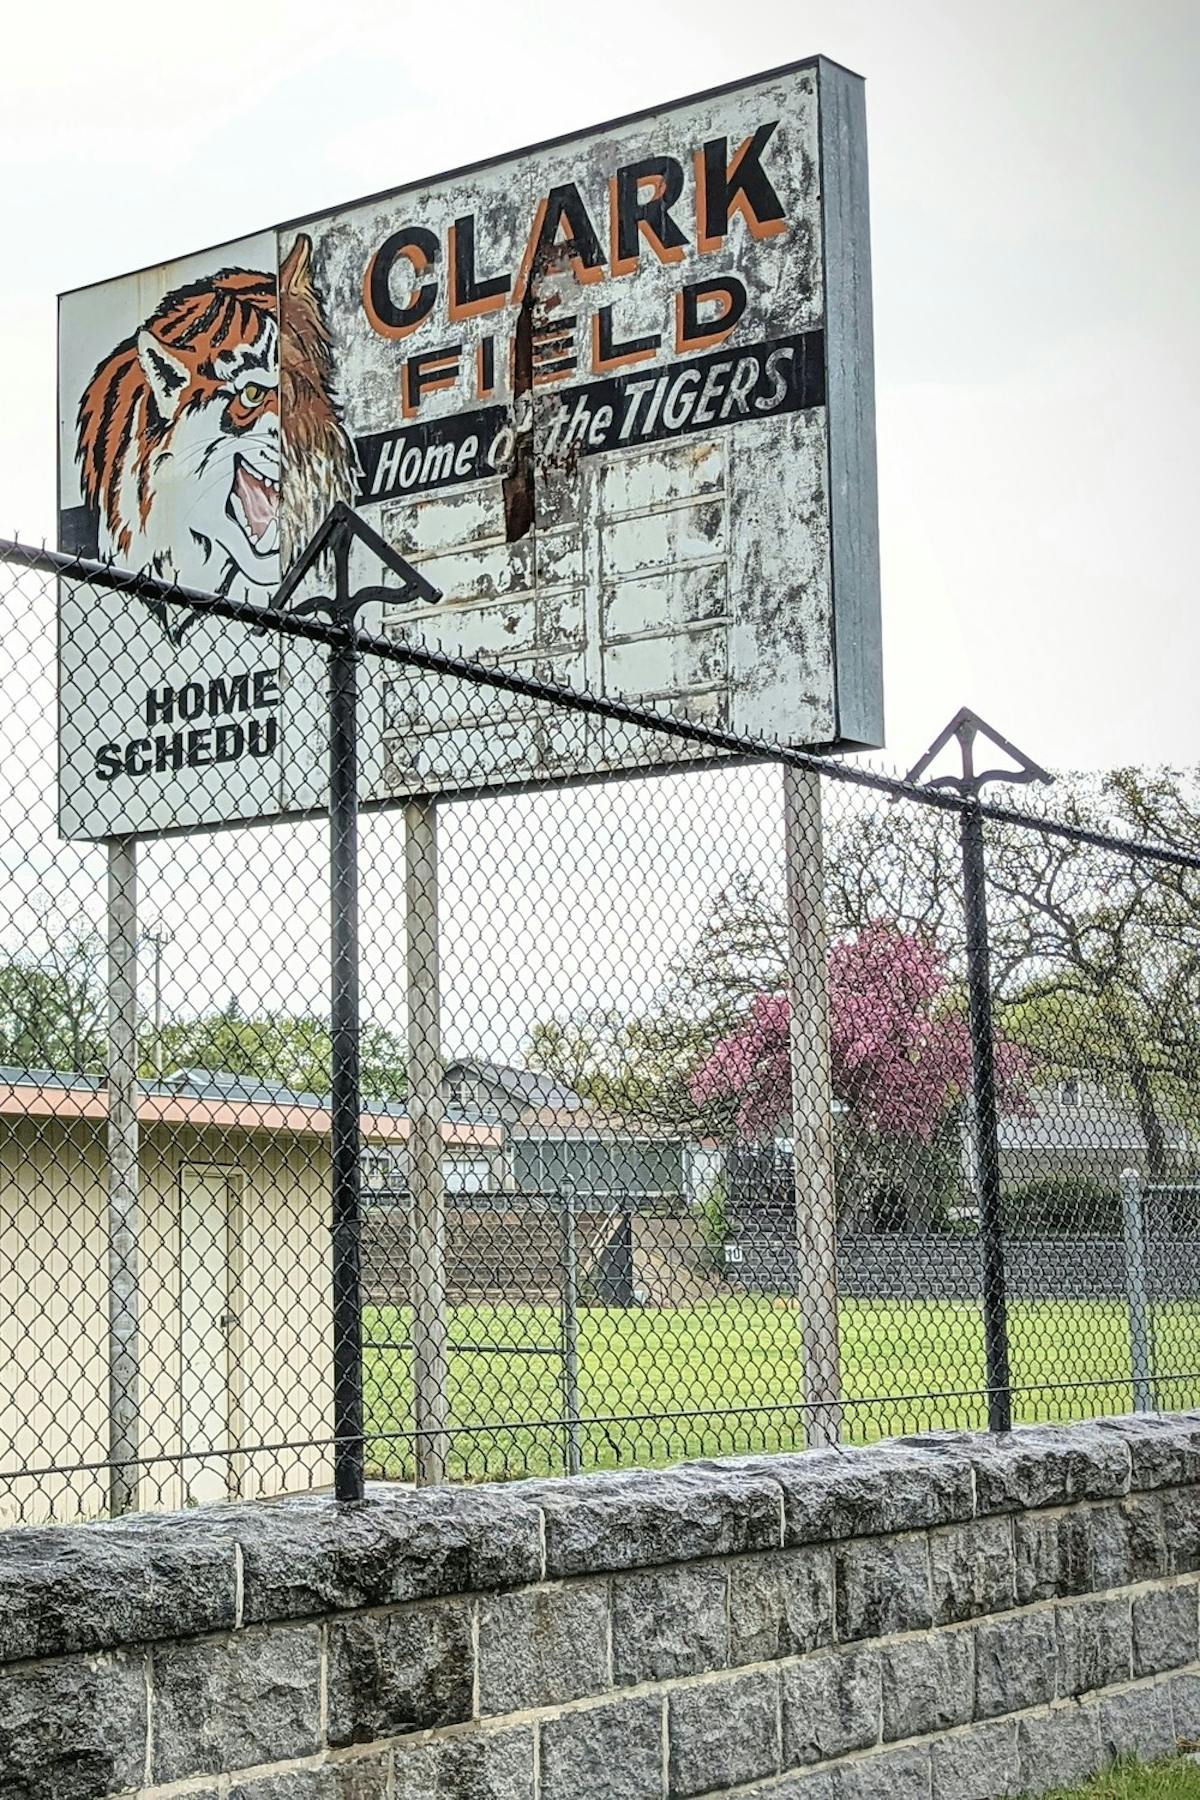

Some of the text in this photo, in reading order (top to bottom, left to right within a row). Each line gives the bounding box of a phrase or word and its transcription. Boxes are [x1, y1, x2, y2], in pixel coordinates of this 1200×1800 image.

[363, 120, 786, 339] CLARK
[402, 276, 747, 418] FIELD
[370, 434, 480, 496] Home
[544, 394, 617, 457] the
[618, 347, 796, 440] TIGERS
[95, 718, 277, 781] SCHEDU
[146, 668, 279, 727] HOME
